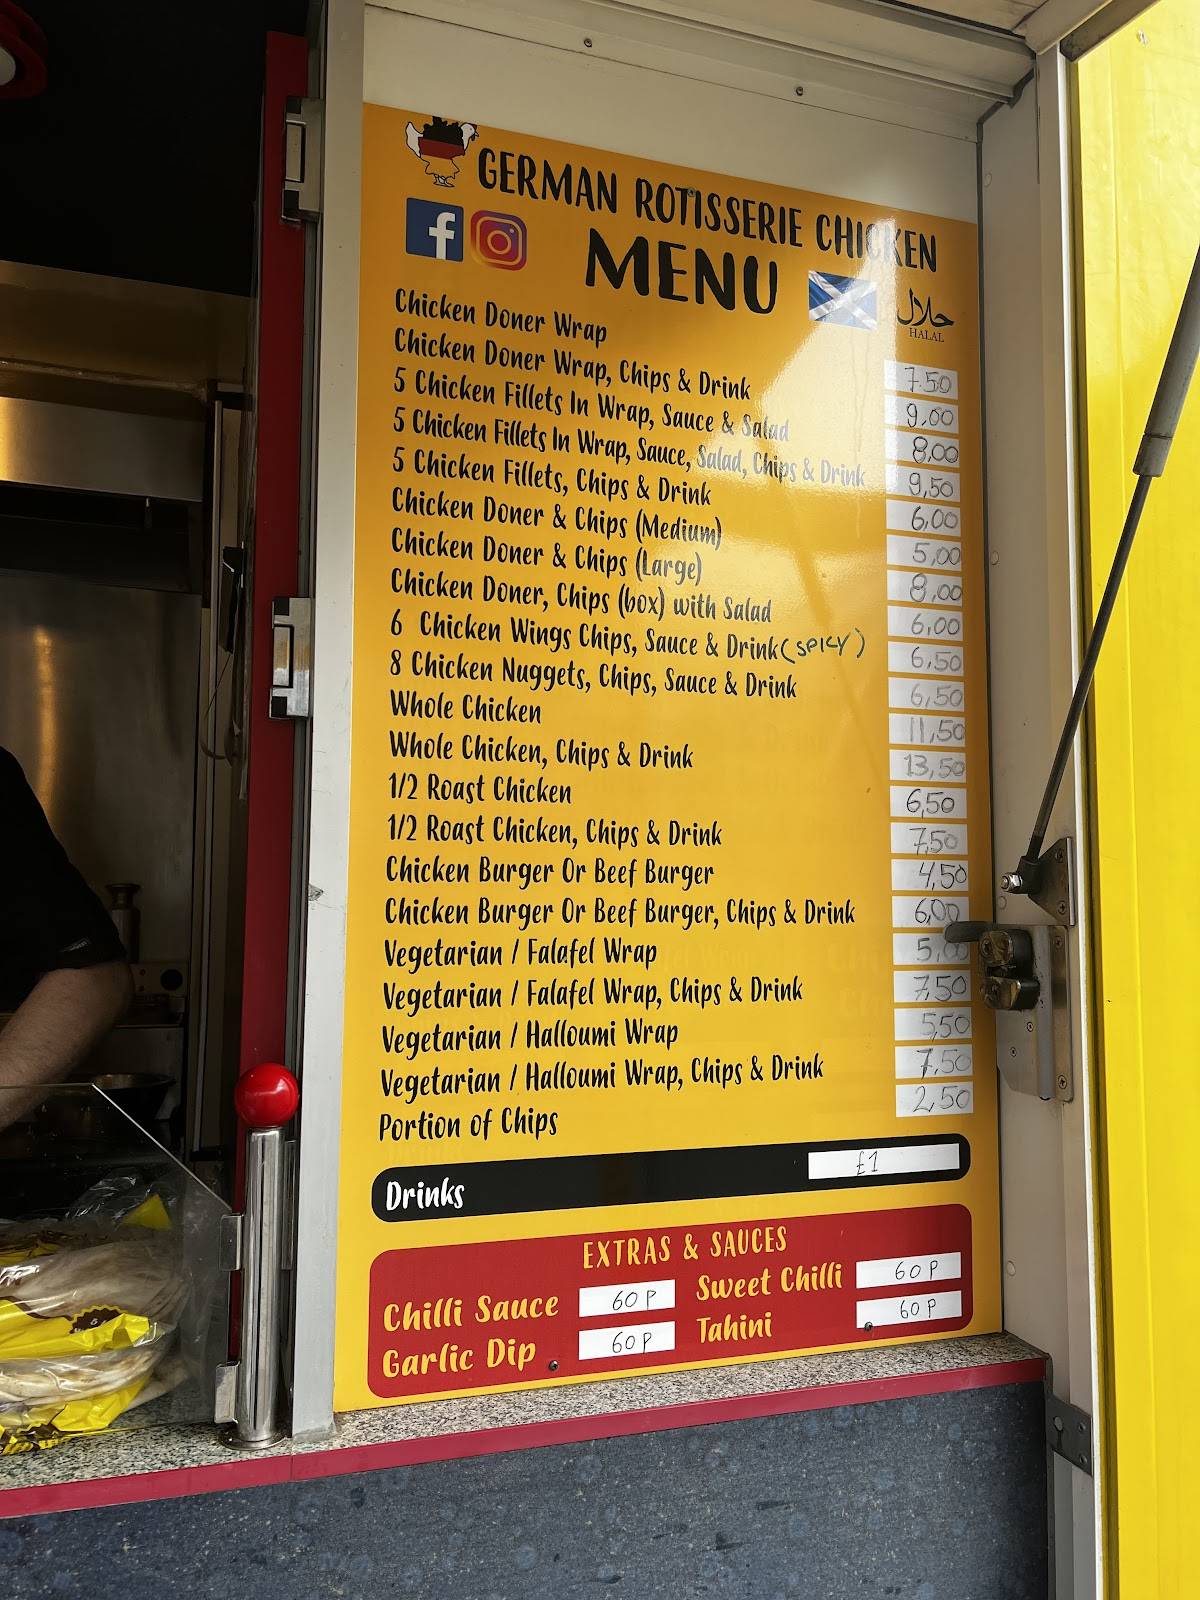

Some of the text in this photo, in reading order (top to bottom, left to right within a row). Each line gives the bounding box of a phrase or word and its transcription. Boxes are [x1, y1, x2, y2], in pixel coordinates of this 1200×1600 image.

[477, 147, 938, 273] GERMAN ROTISSERIE CHICKEN
[585, 227, 778, 315] MENU
[395, 288, 607, 348] Chicken Doner Wrap
[909, 328, 945, 343] HALAL
[395, 328, 750, 400] Chicken Doner Wrap, Chips & Drink
[394, 367, 789, 442] 5 Chicken Fillets In Wrap, Sauce & Salad
[394, 406, 865, 486] 5 Chicken Fillets In Wrap, Sauce, Salad, Chips & Drink
[393, 447, 711, 505] 5 Chicken Fillets, Chips & Drink
[392, 487, 721, 550] Chicken Doner & Chips (Medium)
[392, 527, 701, 586] Chicken Doner & Chips (Large)
[391, 568, 771, 622] Chicken Doner, Chips (box) with Salad
[391, 609, 777, 661] 6 Chicken Wings Chips, Sauce & Drink
[390, 650, 797, 698] 8 Chicken Nuggets, Chips, Sauce & Drink
[390, 690, 541, 723] Whole Chicken
[389, 730, 694, 771] Whole Chicken, Chips & Drink
[388, 773, 572, 804] 1/2 Roast Chicken
[388, 814, 722, 850] 1/2 Roast Chicken, Chips & Drink
[386, 855, 714, 891] Chicken Burger Or Beef Burger
[385, 897, 855, 931] Chicken Burger Or Beef Burger, Chips & Drink
[384, 937, 657, 974] Vegetarian / Falafel Wrap
[383, 976, 803, 1017] Vegetarian / Falafel Wrap, Chips & Drink
[382, 1018, 678, 1060] Vegetarian / Halloumi Wrap
[381, 1053, 824, 1104] Vegetarian / Halloumi Wrap, Chips & Drink
[379, 1106, 559, 1141] Portion of Chips
[386, 1177, 464, 1211] Drinks
[583, 1226, 787, 1269] EXTRAS & SAUCES
[696, 1262, 842, 1301] Sweet Chilli
[383, 1295, 559, 1332] Chilli Sauce
[696, 1312, 772, 1343] Tahini
[382, 1338, 536, 1378] Garlic Dip
